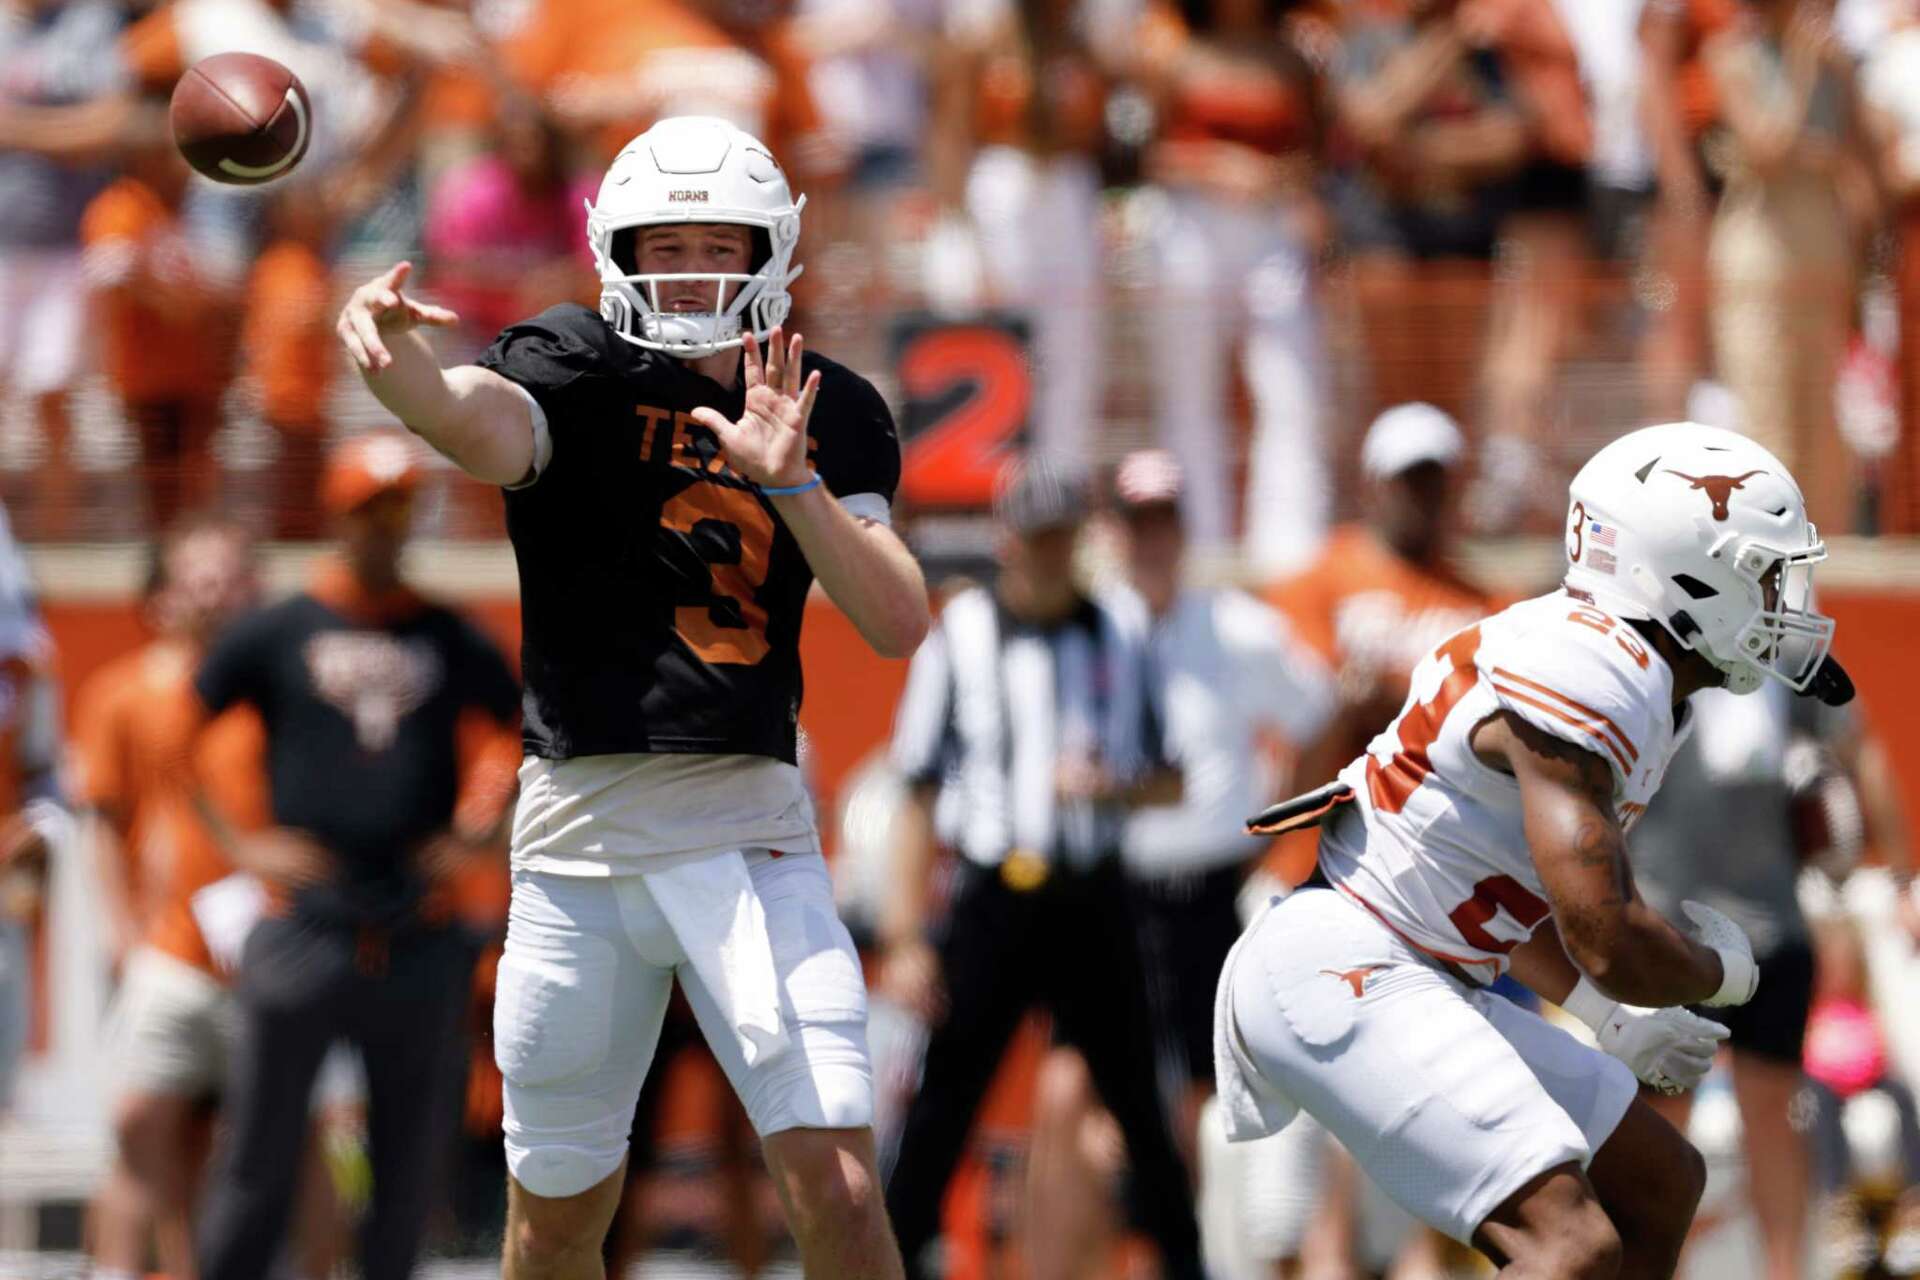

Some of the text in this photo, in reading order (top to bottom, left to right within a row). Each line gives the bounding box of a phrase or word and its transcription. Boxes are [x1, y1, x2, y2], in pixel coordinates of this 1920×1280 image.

[668, 190, 709, 202] HORNS
[898, 324, 1034, 507] 2
[659, 480, 775, 666] 3
